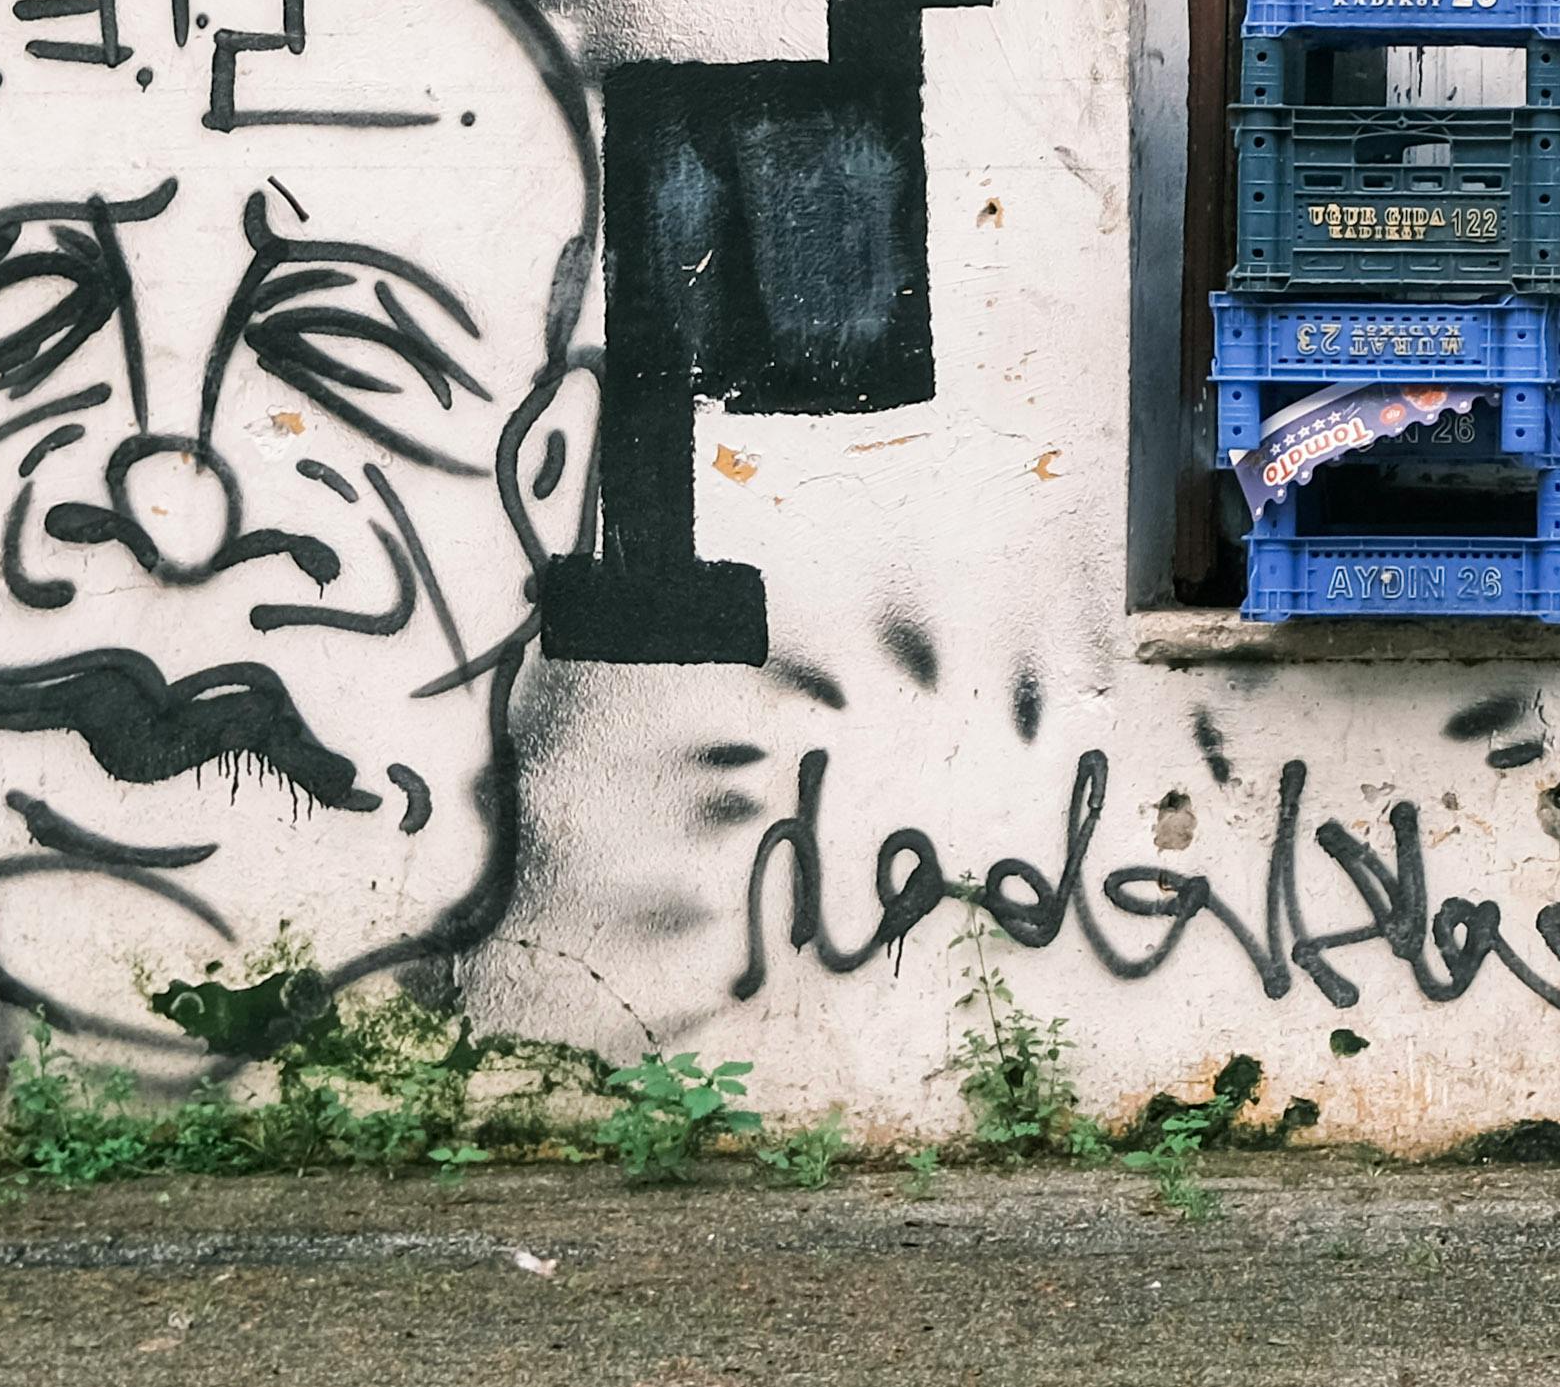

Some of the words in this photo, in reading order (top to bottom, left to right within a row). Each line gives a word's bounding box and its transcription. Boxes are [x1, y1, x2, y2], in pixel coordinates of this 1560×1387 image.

[1384, 206, 1446, 226] GIDA
[1451, 208, 1498, 238] 122
[1296, 323, 1342, 356] 23
[1349, 337, 1466, 356] MURAT
[1431, 411, 1476, 444] 26
[1326, 565, 1446, 599] AYDIN
[1456, 566, 1503, 599] 26
